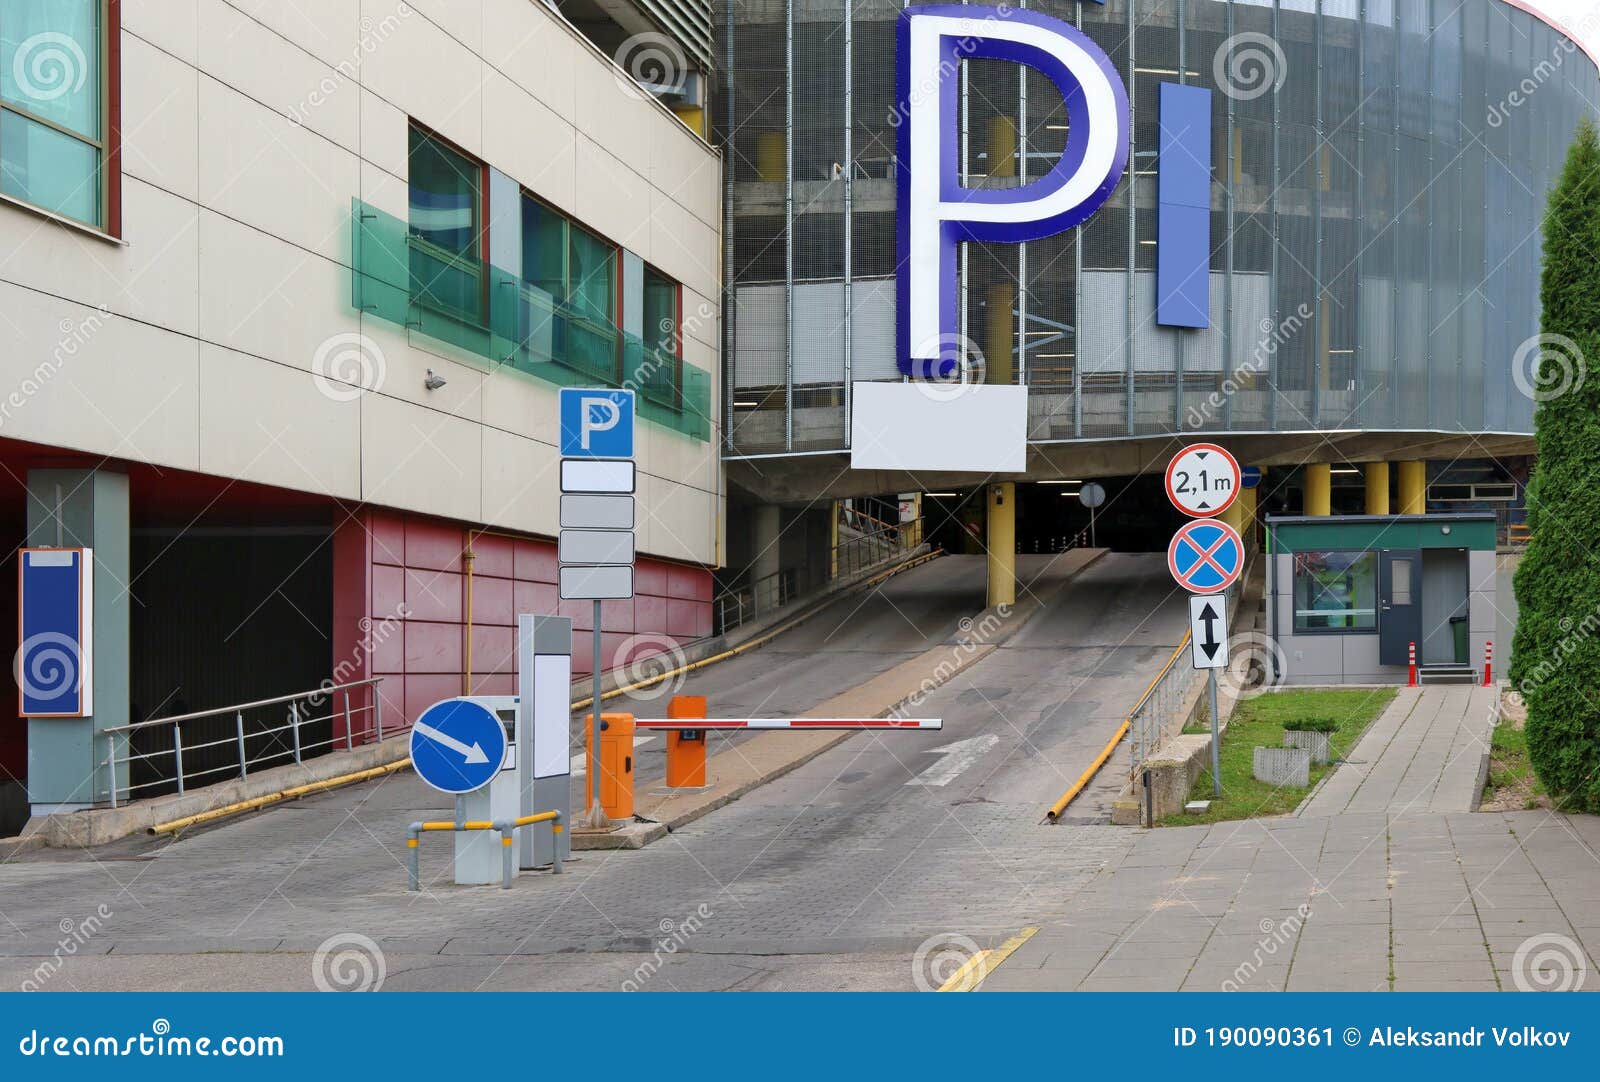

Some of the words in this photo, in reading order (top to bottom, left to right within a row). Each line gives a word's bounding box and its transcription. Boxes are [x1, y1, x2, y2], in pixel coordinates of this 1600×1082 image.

[896, 4, 1130, 376] P
[581, 397, 620, 449] P
[1175, 470, 1208, 496] 2,1
[1214, 478, 1231, 491] m
